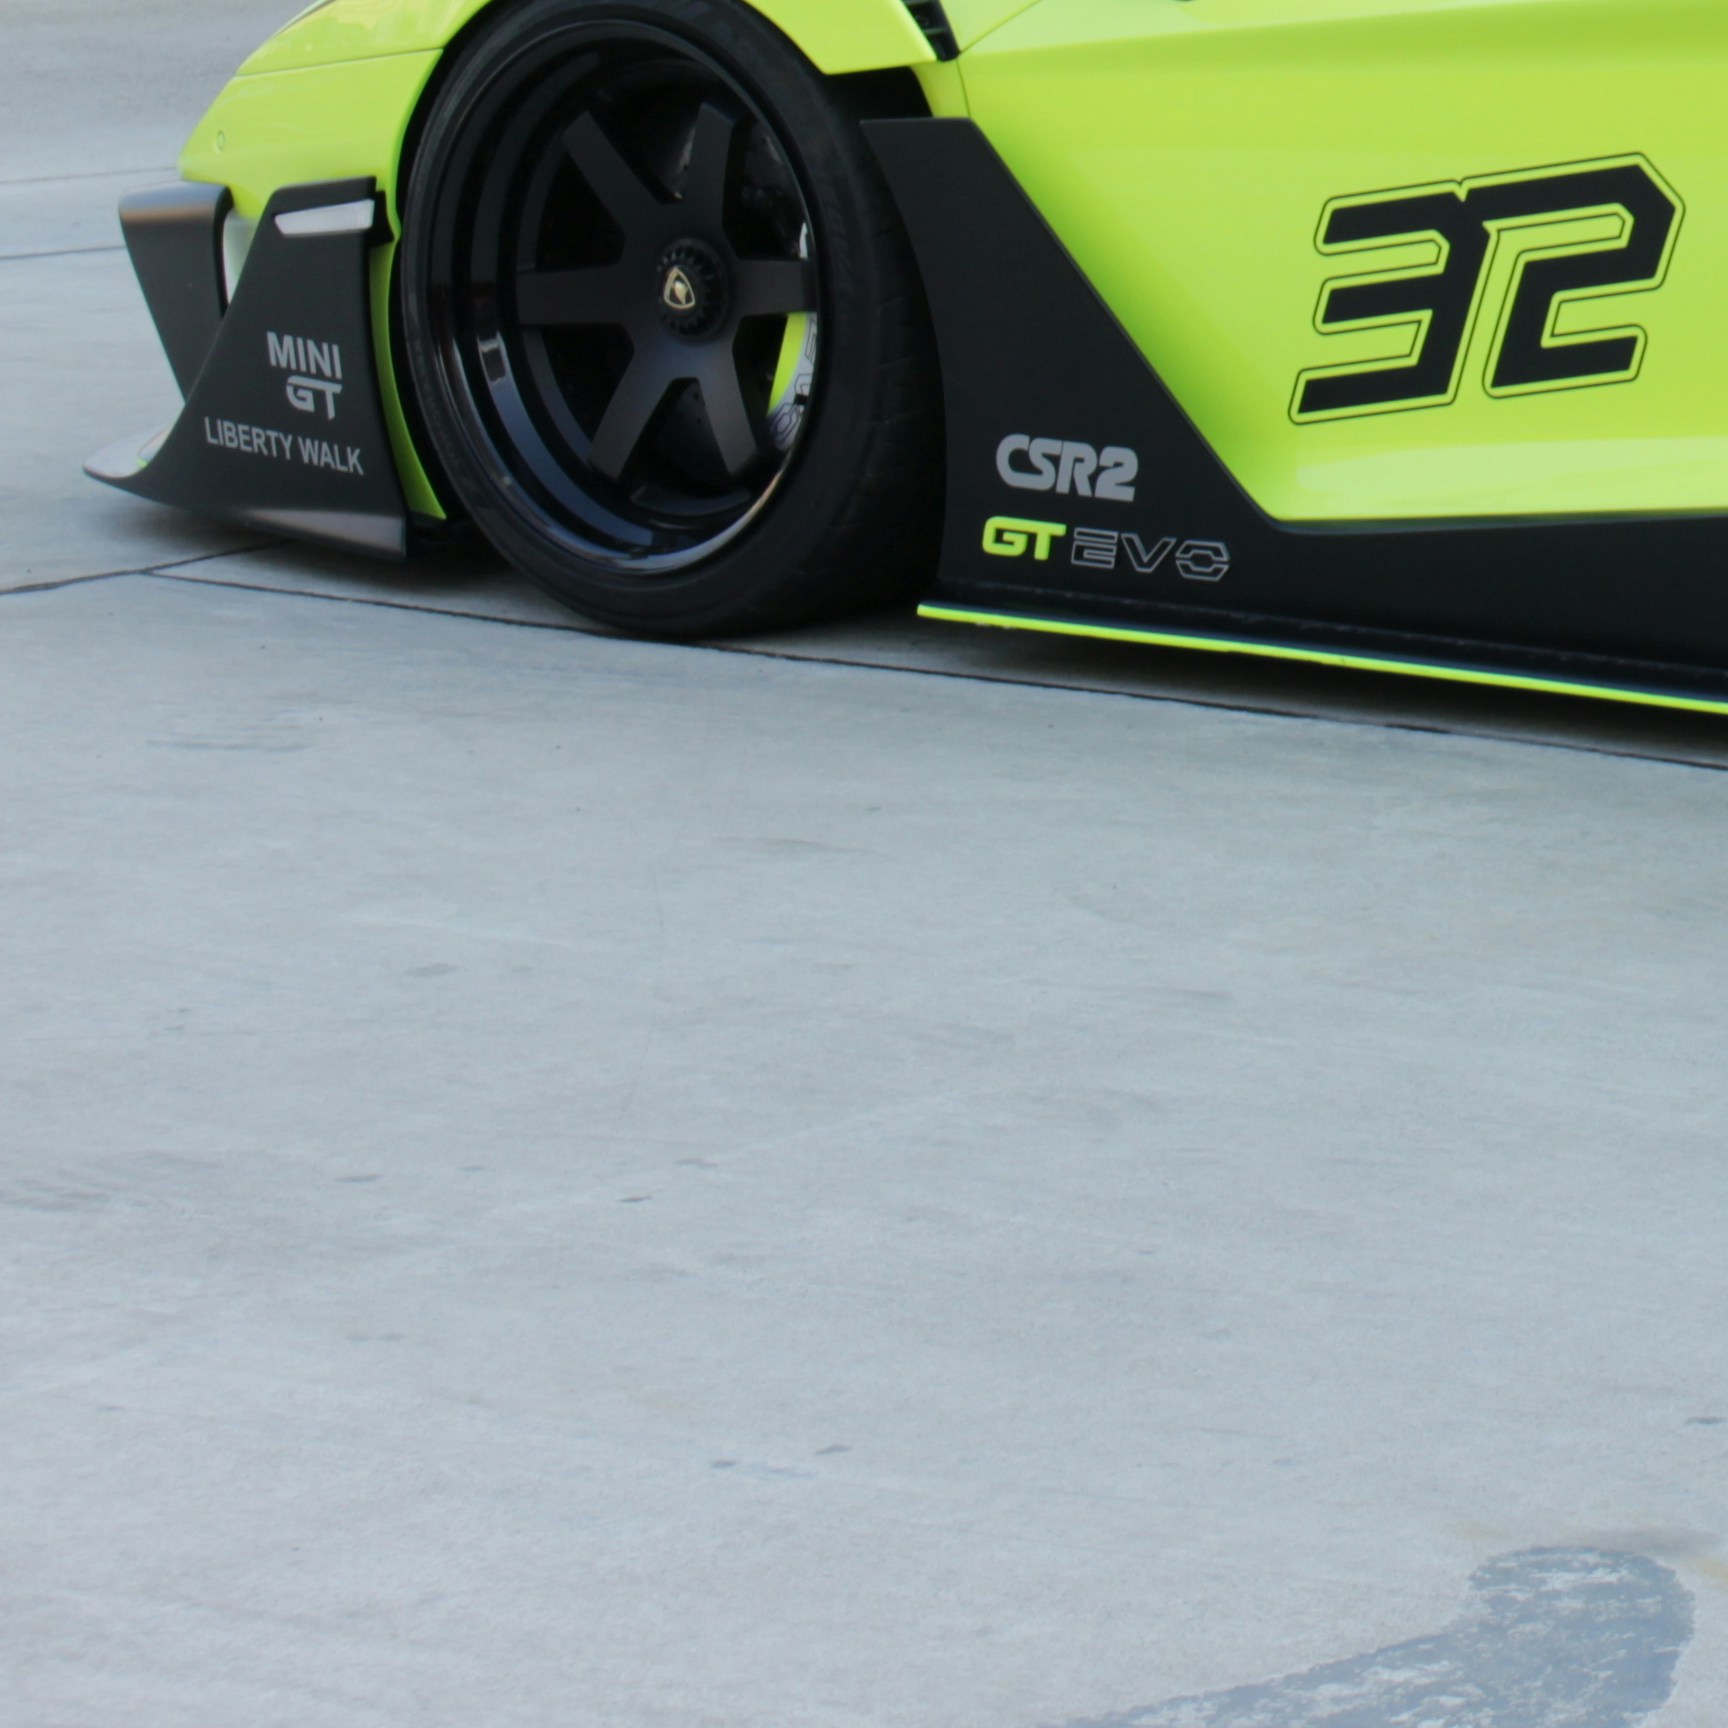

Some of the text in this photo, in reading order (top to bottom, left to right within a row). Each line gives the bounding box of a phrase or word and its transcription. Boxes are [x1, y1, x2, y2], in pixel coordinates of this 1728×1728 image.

[1288, 152, 1685, 424] 32
[266, 331, 343, 380] MINI
[285, 375, 343, 420] GT
[205, 417, 363, 475] LIBERTY WALK
[996, 433, 1138, 502] CSR2
[982, 516, 1230, 582] GT EVO
